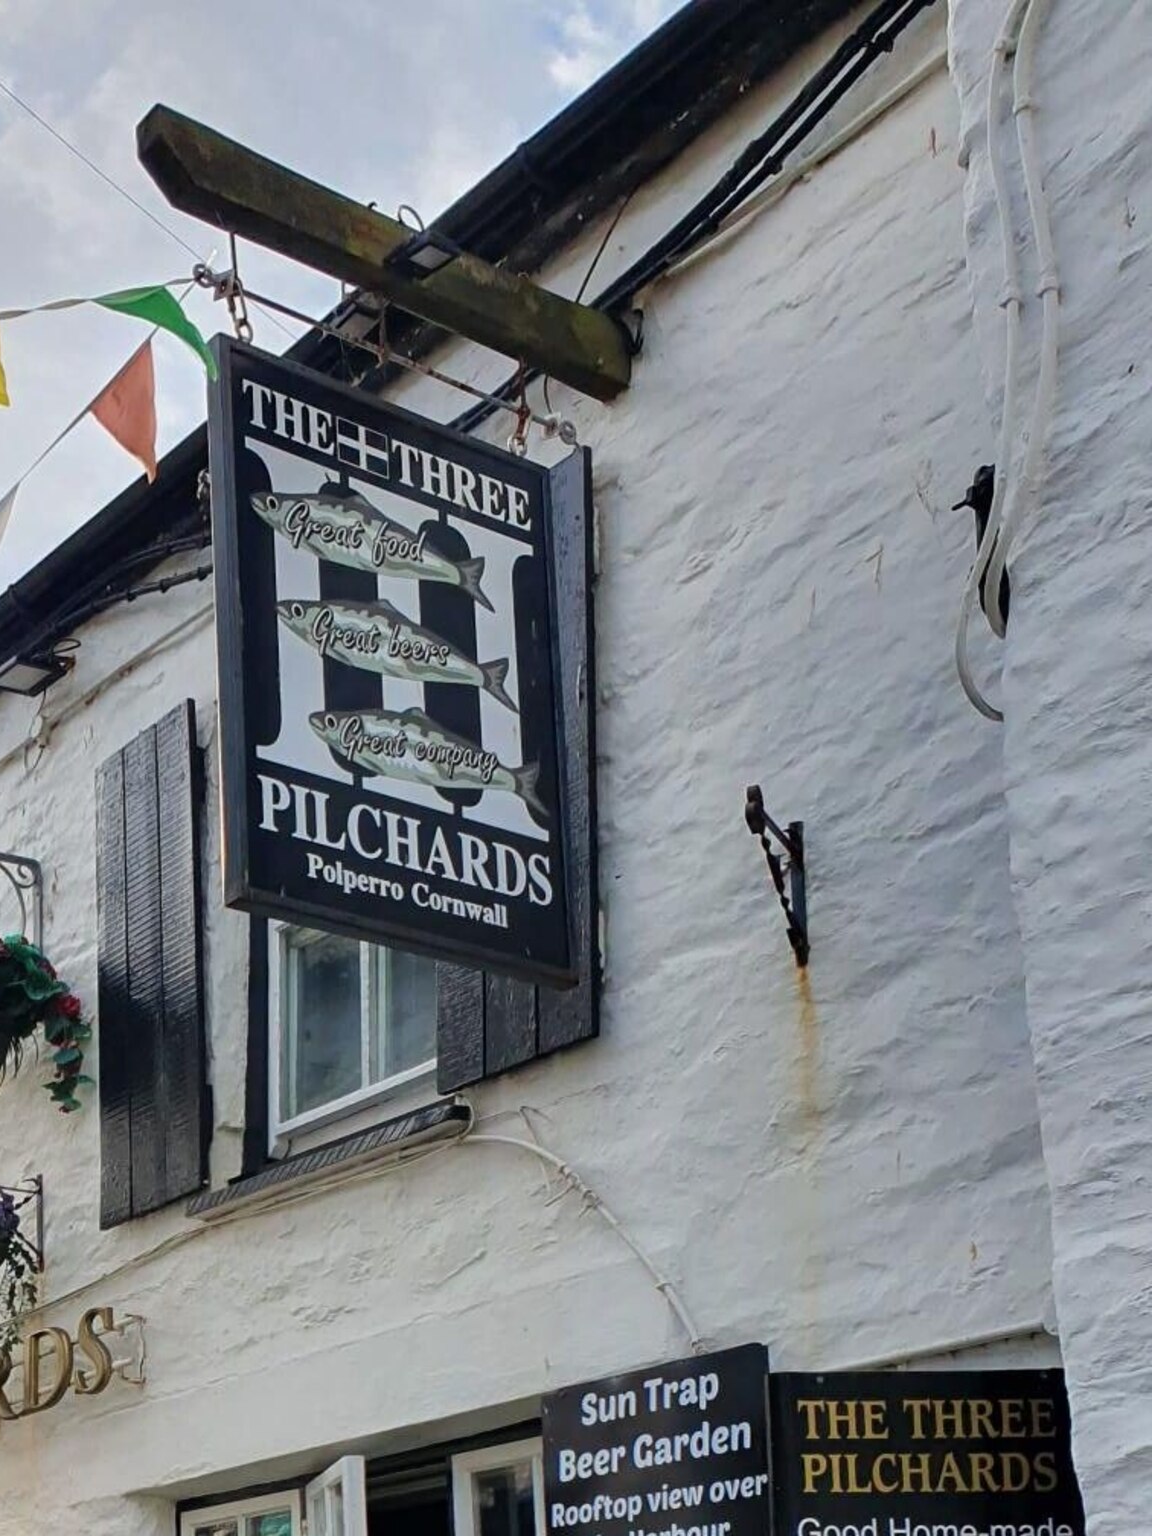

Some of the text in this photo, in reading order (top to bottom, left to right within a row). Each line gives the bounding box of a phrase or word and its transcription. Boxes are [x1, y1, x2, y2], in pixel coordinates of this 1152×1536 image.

[243, 378, 532, 533] THE THREE
[285, 501, 426, 566] Great food
[313, 608, 450, 665] Great beers
[339, 716, 499, 784] Great company
[257, 774, 553, 906] PILCHARDS
[306, 852, 509, 929] Polperro Cornwall
[581, 1372, 720, 1426] Sun Trap
[798, 1398, 1057, 1440] THE THREE
[558, 1421, 752, 1483] Beer Garden
[801, 1452, 1059, 1493] PILCHARDS
[551, 1473, 768, 1528] Rooftop view over
